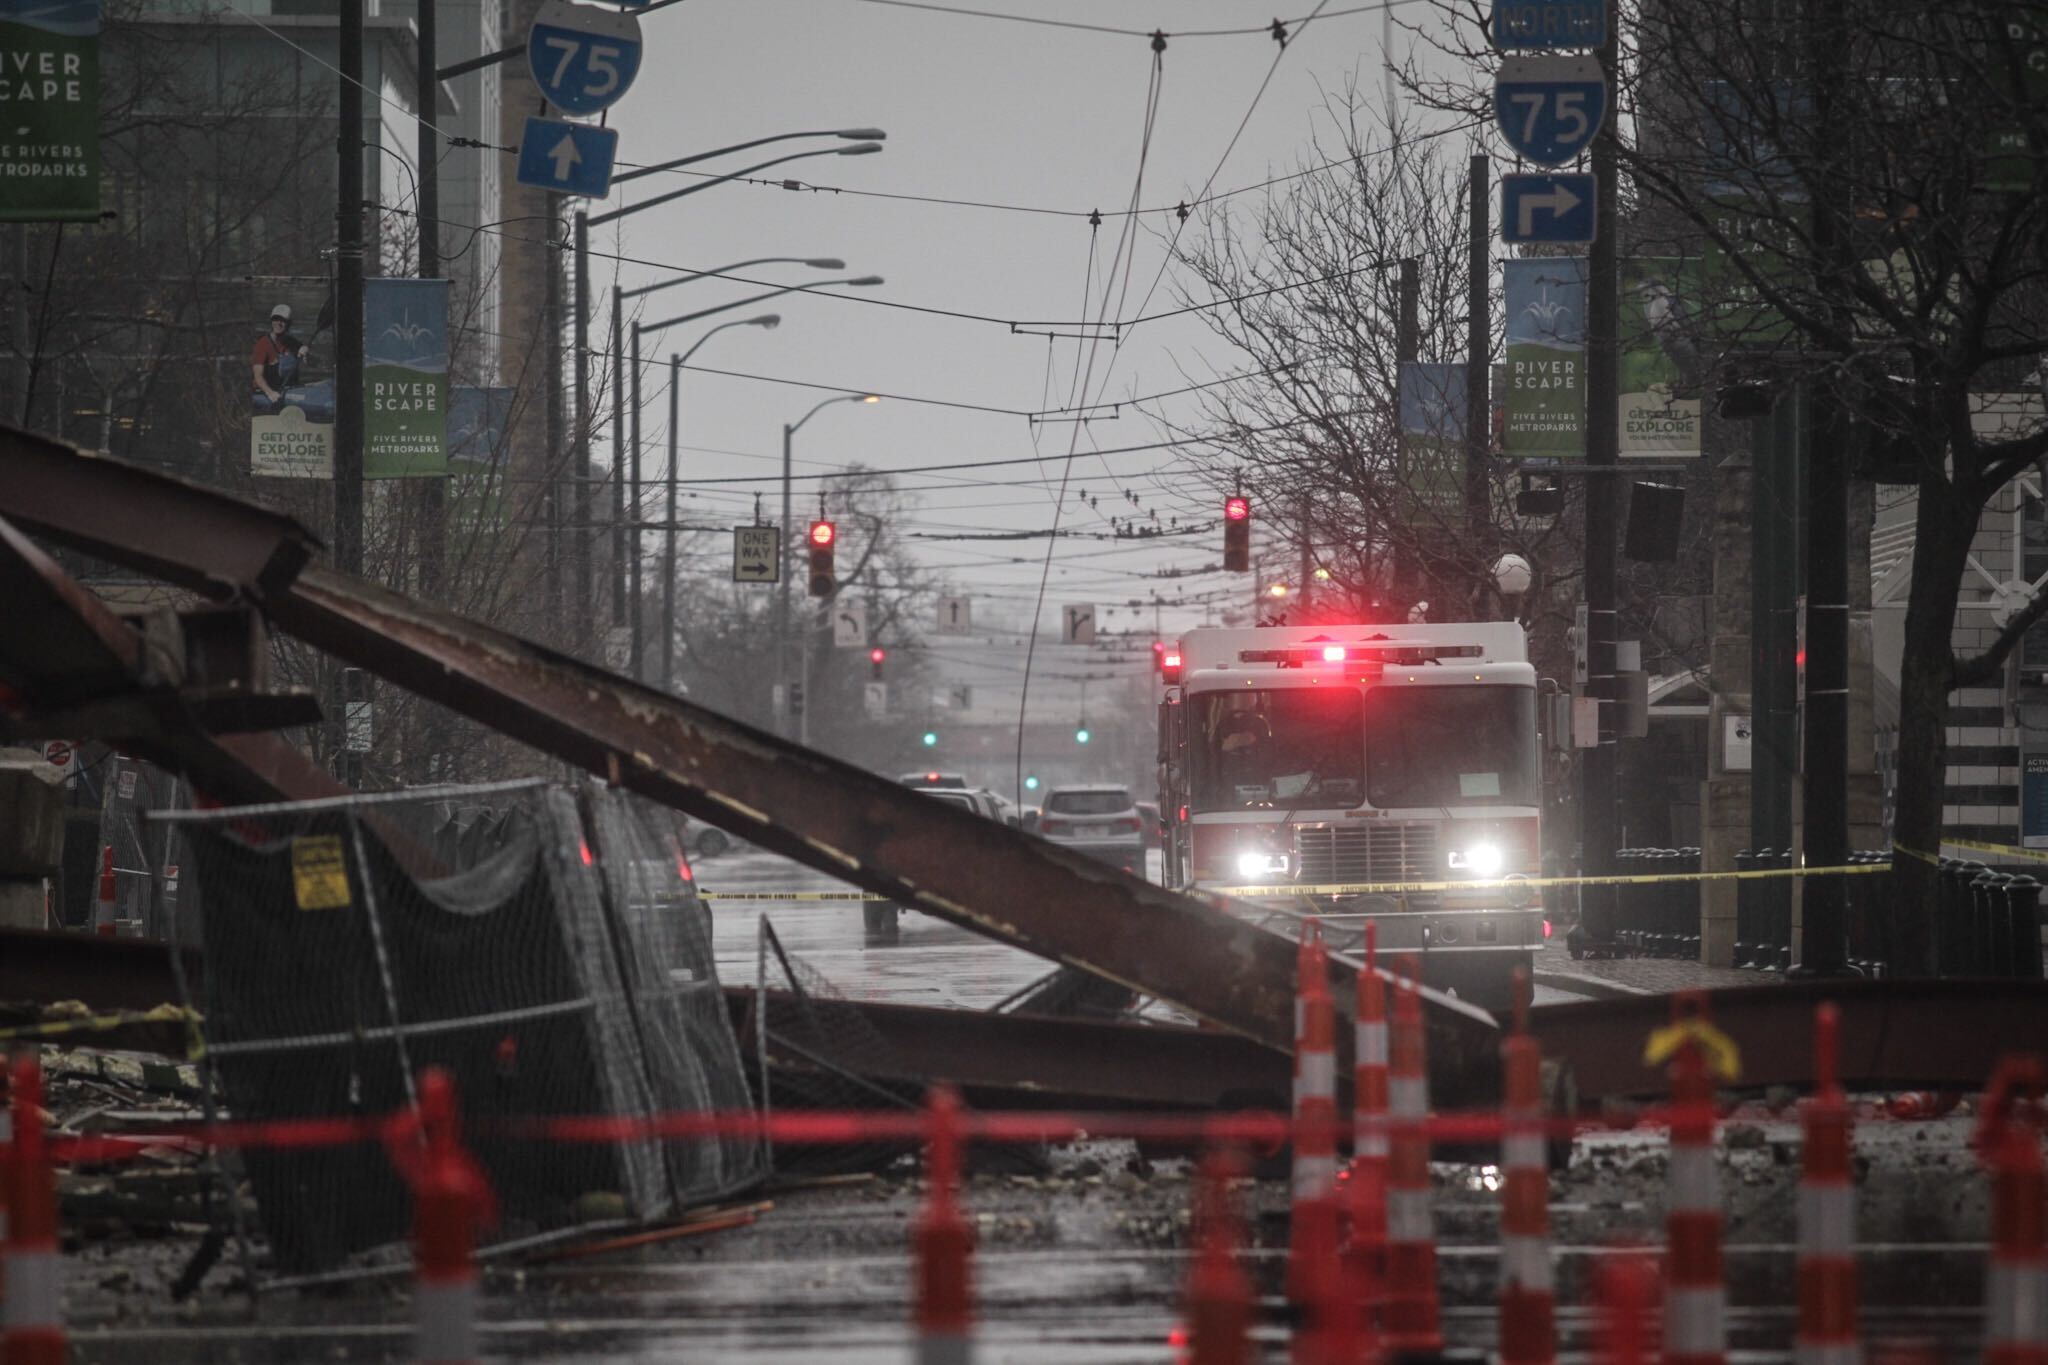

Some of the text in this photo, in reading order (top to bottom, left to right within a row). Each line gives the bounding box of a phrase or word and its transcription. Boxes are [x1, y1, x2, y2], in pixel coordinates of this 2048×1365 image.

[1500, 6, 1600, 38] NORTH
[545, 36, 620, 97] 75
[1510, 92, 1589, 145] 75
[19, 144, 84, 158] RIVERS
[1515, 361, 1575, 374] RIVER
[1514, 376, 1576, 389] SCAPE
[375, 383, 436, 396] RIVER
[374, 398, 436, 411] SCAPE
[1510, 423, 1578, 432] METROPARKS
[1626, 421, 1694, 433] EXPLORE
[260, 432, 284, 442] GET
[287, 432, 312, 442] OUT
[373, 435, 437, 443] FIVE RIVERS
[258, 443, 326, 456] EXPLORE
[371, 445, 440, 453] METROPARKS
[743, 532, 769, 545] ONE
[742, 547, 770, 559] WAY
